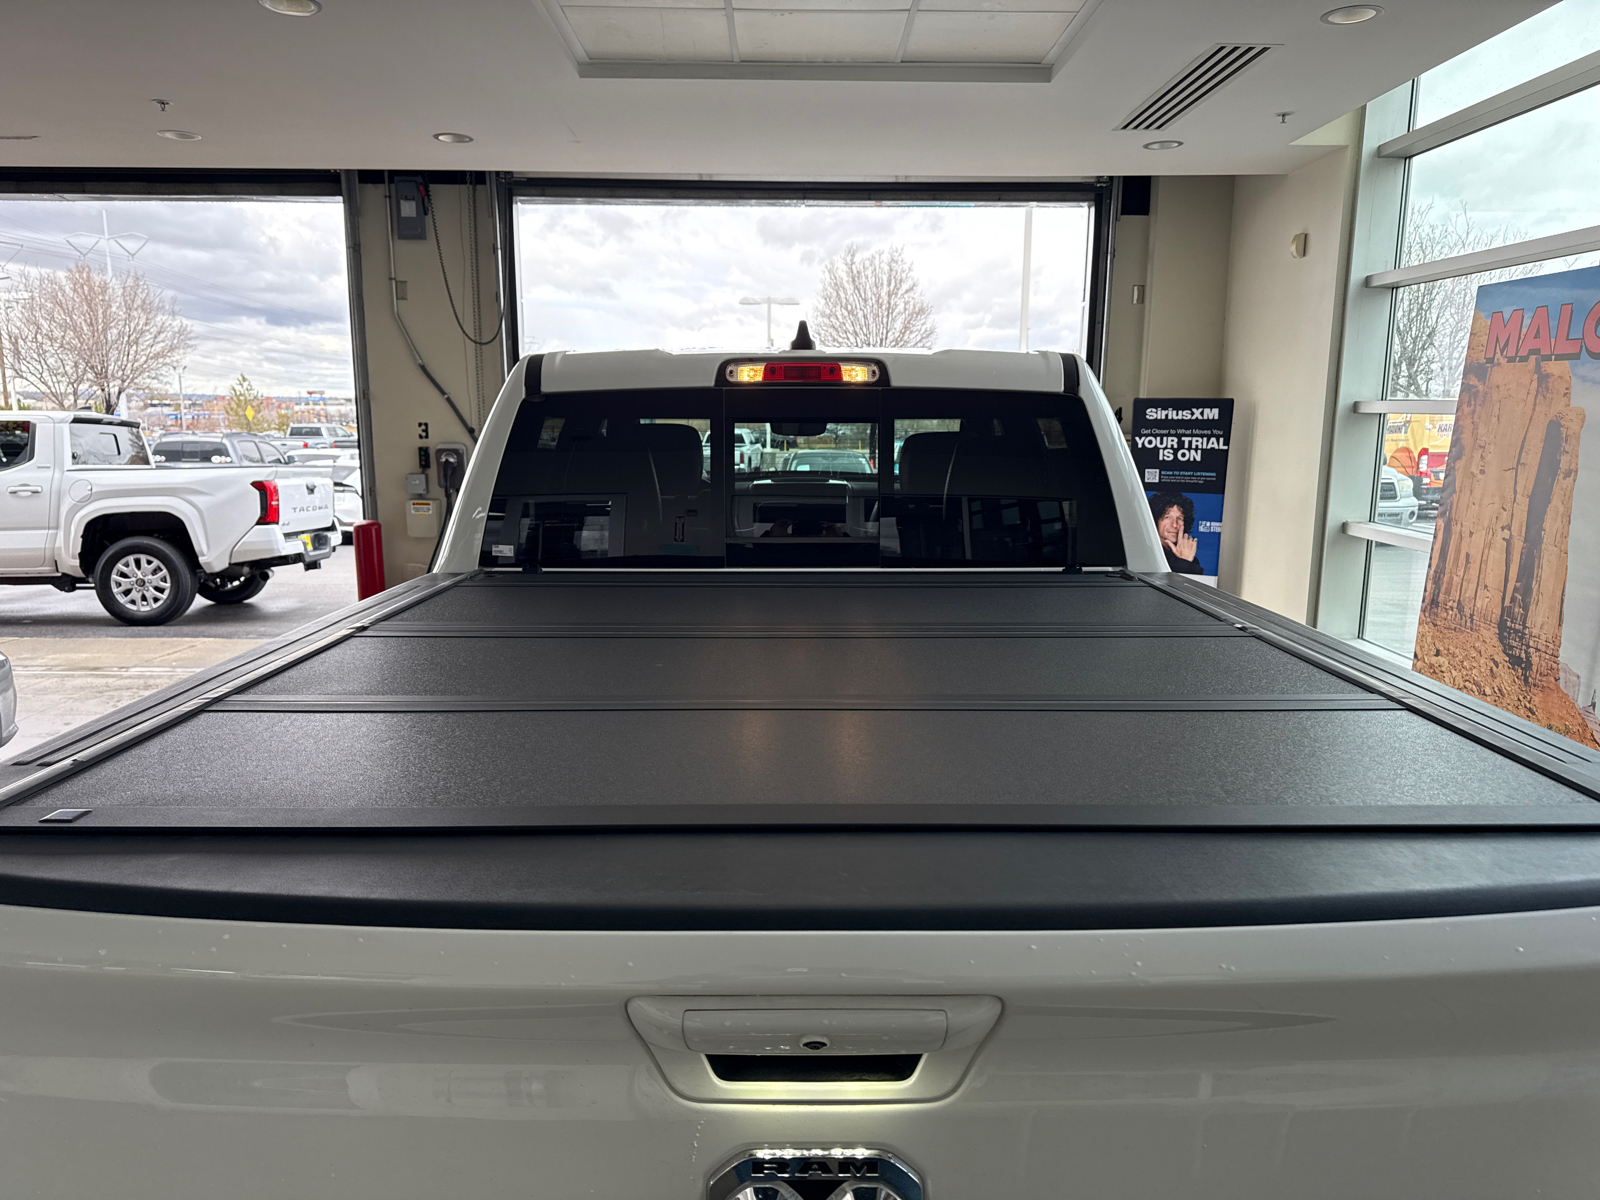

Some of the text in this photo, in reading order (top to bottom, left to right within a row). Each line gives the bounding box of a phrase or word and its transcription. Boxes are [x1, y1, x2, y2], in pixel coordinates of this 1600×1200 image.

[1145, 407, 1219, 420] SiriusXM
[418, 422, 429, 439] 3
[1135, 436, 1228, 450] YOUR TRIAL
[1158, 448, 1201, 462] IS ON
[291, 504, 329, 513] TACOMA
[750, 1161, 880, 1177] RAM
